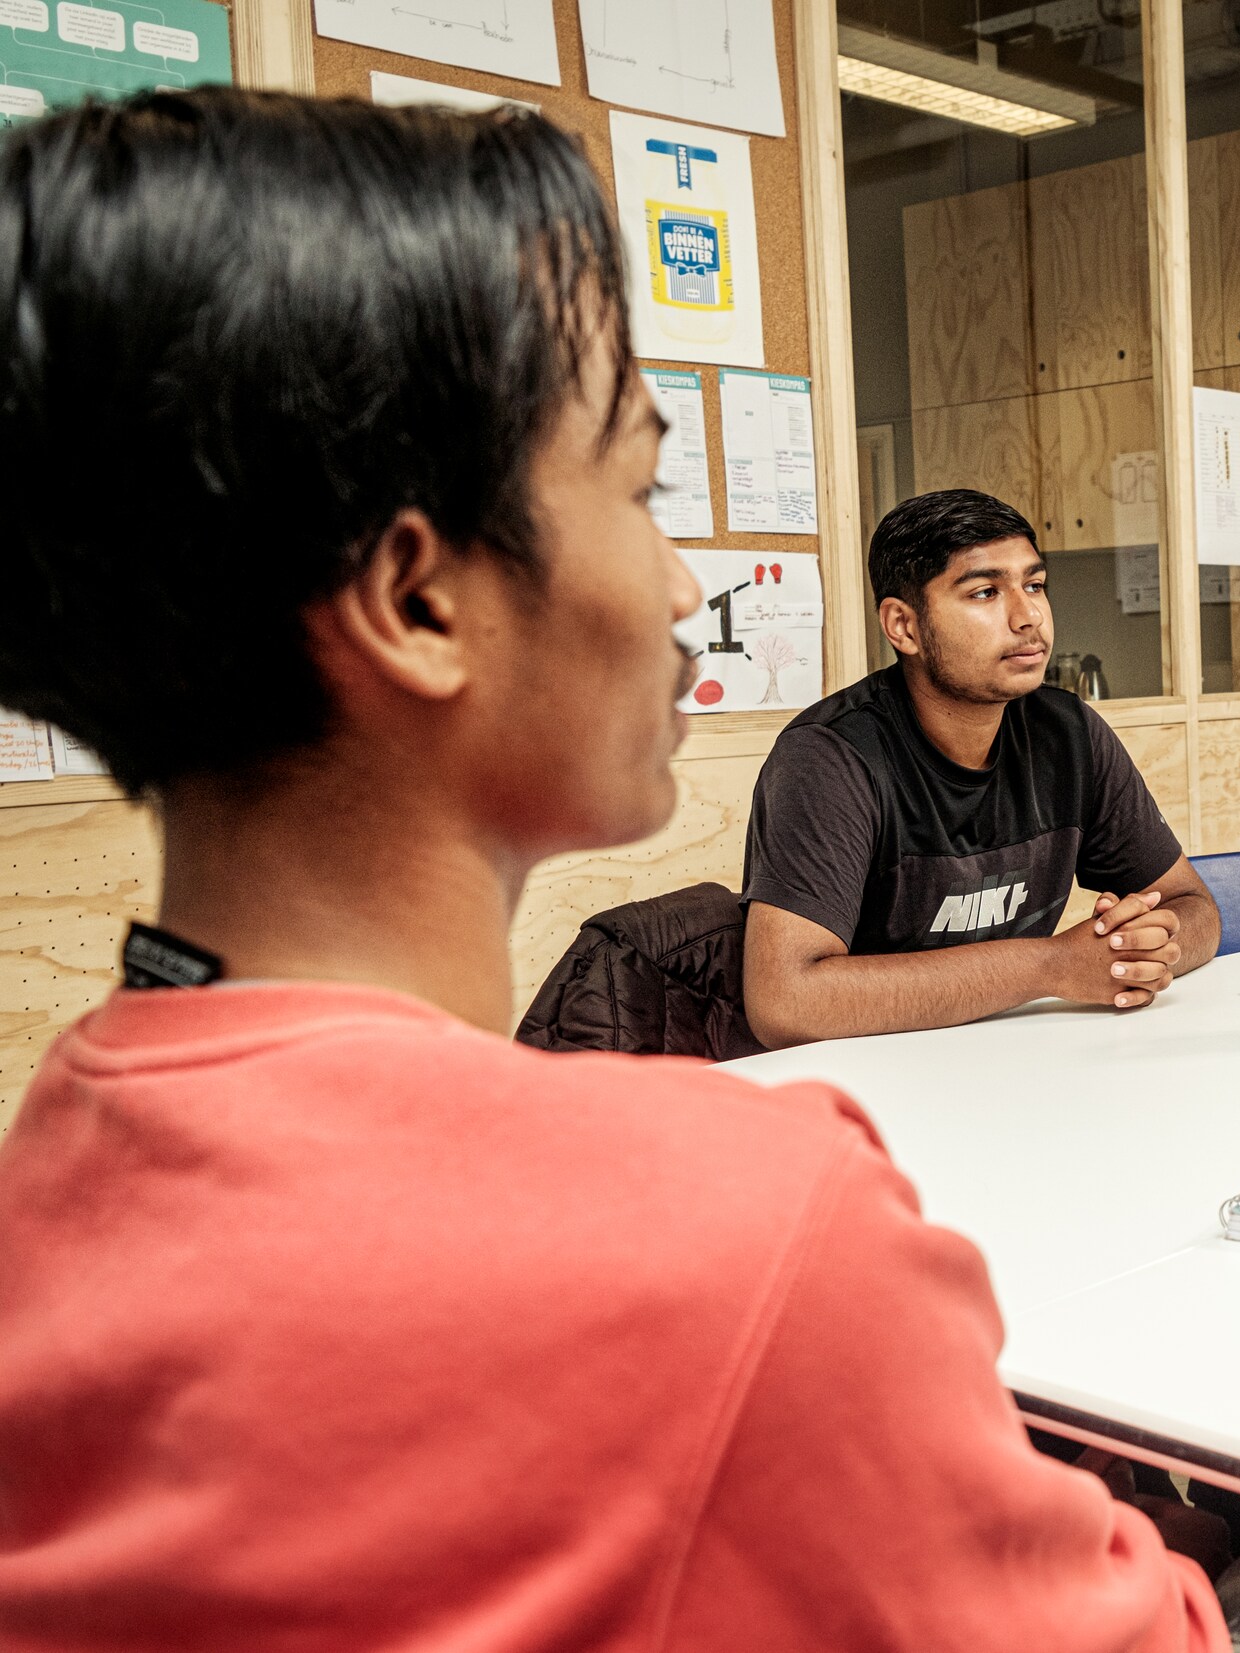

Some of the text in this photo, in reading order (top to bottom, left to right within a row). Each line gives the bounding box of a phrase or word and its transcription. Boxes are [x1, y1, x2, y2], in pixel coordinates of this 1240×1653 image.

[678, 146, 689, 183] FRESH
[664, 232, 714, 252] BINNEN
[666, 245, 713, 264] VETTER
[658, 374, 697, 388] KIESKOMPAS
[770, 379, 806, 391] KIESKOMPAS
